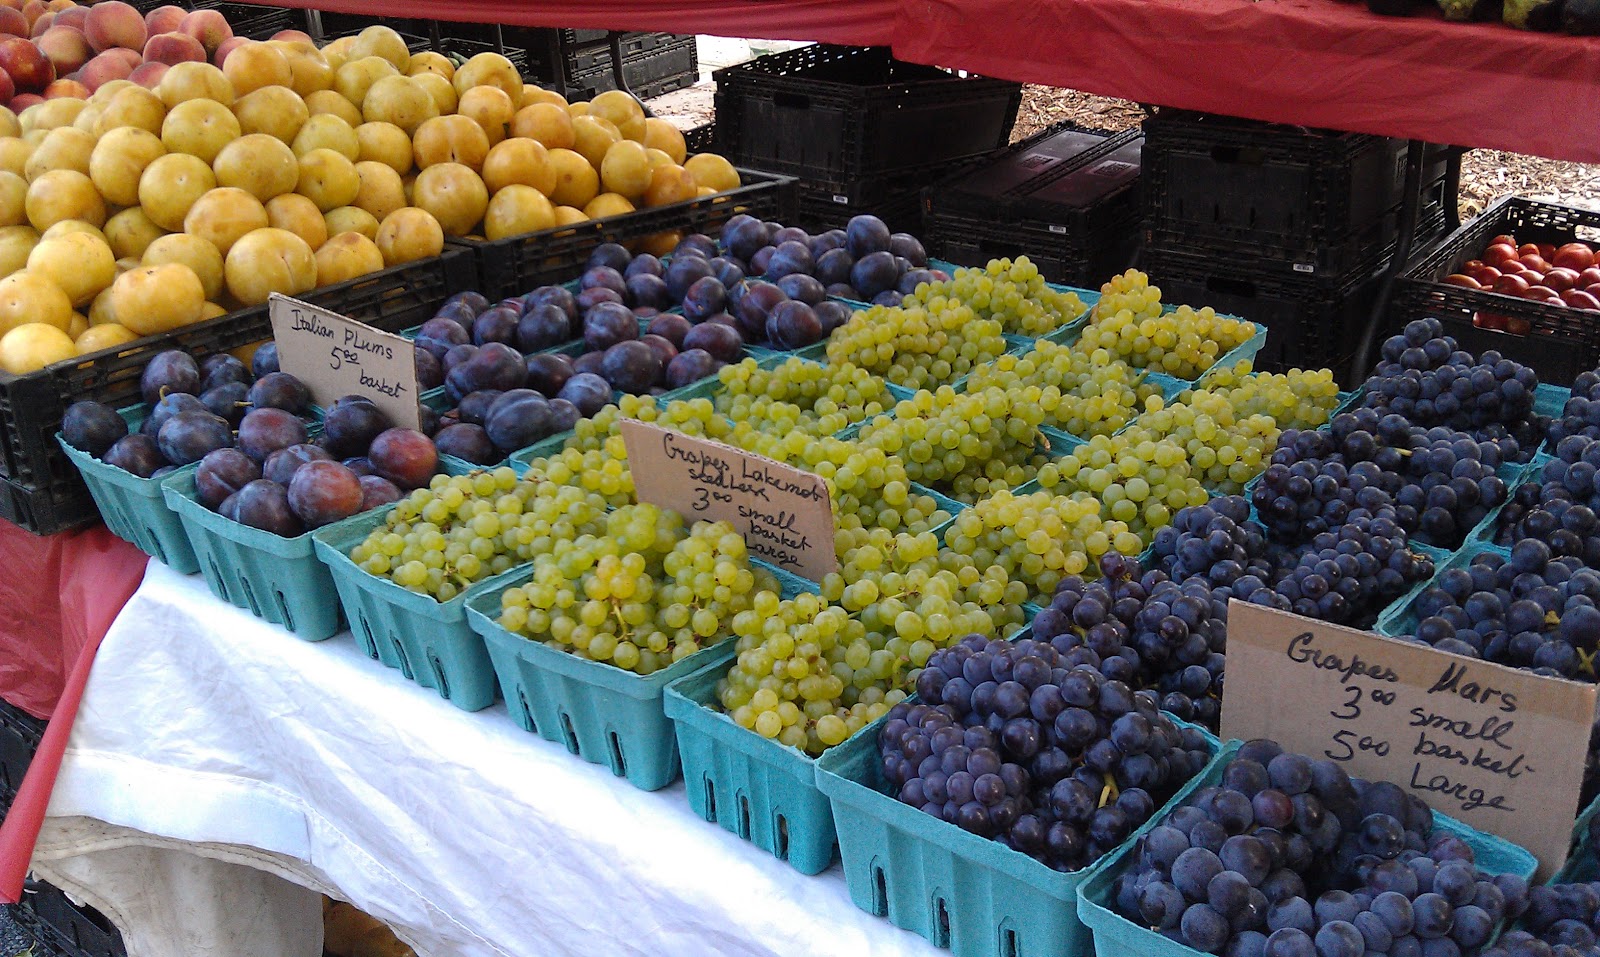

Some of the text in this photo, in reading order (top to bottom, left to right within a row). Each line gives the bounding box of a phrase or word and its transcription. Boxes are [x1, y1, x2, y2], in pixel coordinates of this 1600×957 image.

[291, 309, 334, 339] Italian
[359, 369, 407, 398] basket
[738, 505, 800, 535] small
[750, 520, 812, 550] basket
[744, 532, 804, 568] Large
[1287, 632, 1517, 713] Grapes Mars
[1409, 707, 1515, 751] small
[1411, 732, 1536, 779] basket
[1410, 763, 1516, 811] Large
